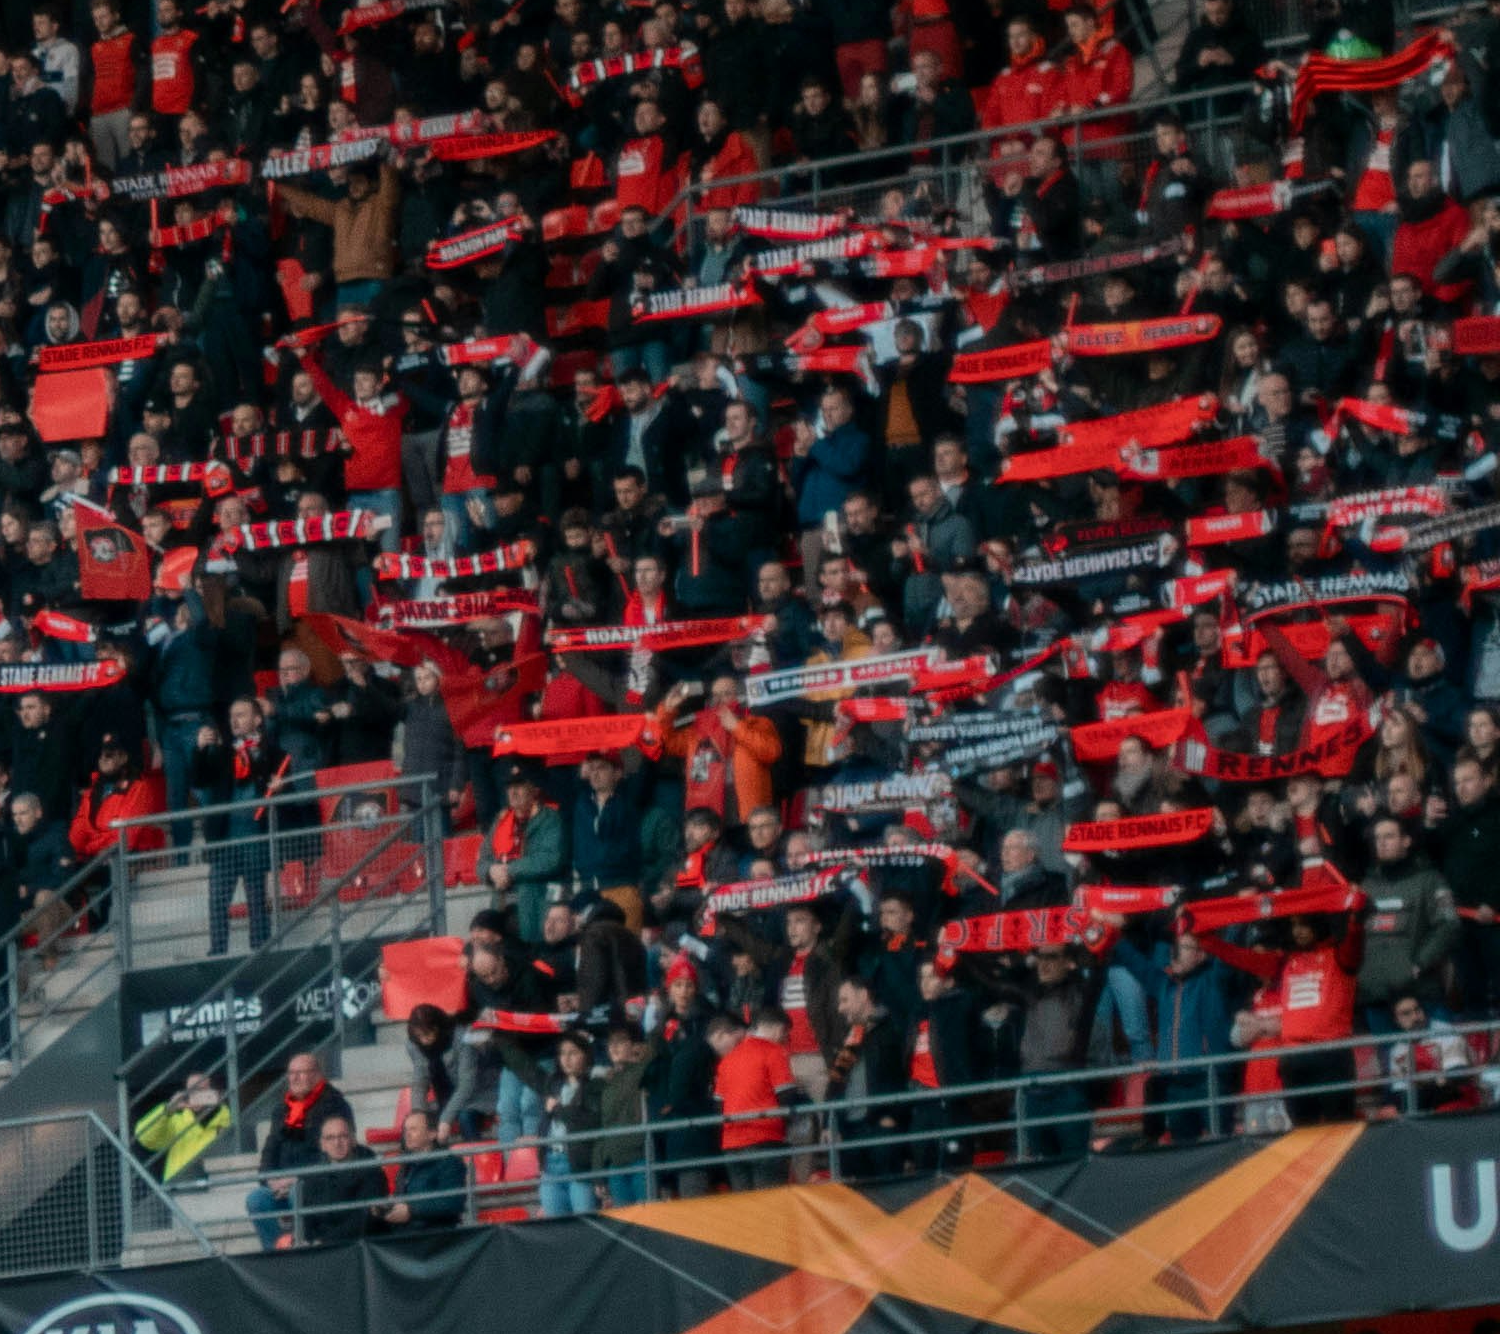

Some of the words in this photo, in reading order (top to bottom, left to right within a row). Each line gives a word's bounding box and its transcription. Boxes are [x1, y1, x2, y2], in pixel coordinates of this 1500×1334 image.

[0, 666, 33, 687] STADE
[1217, 717, 1366, 779] RENNES
[1068, 820, 1113, 843] STADE
[1116, 815, 1182, 840] RENNAIS
[707, 891, 751, 914] STADE
[752, 884, 813, 909] RENNAIS
[1430, 1162, 1500, 1253] U
